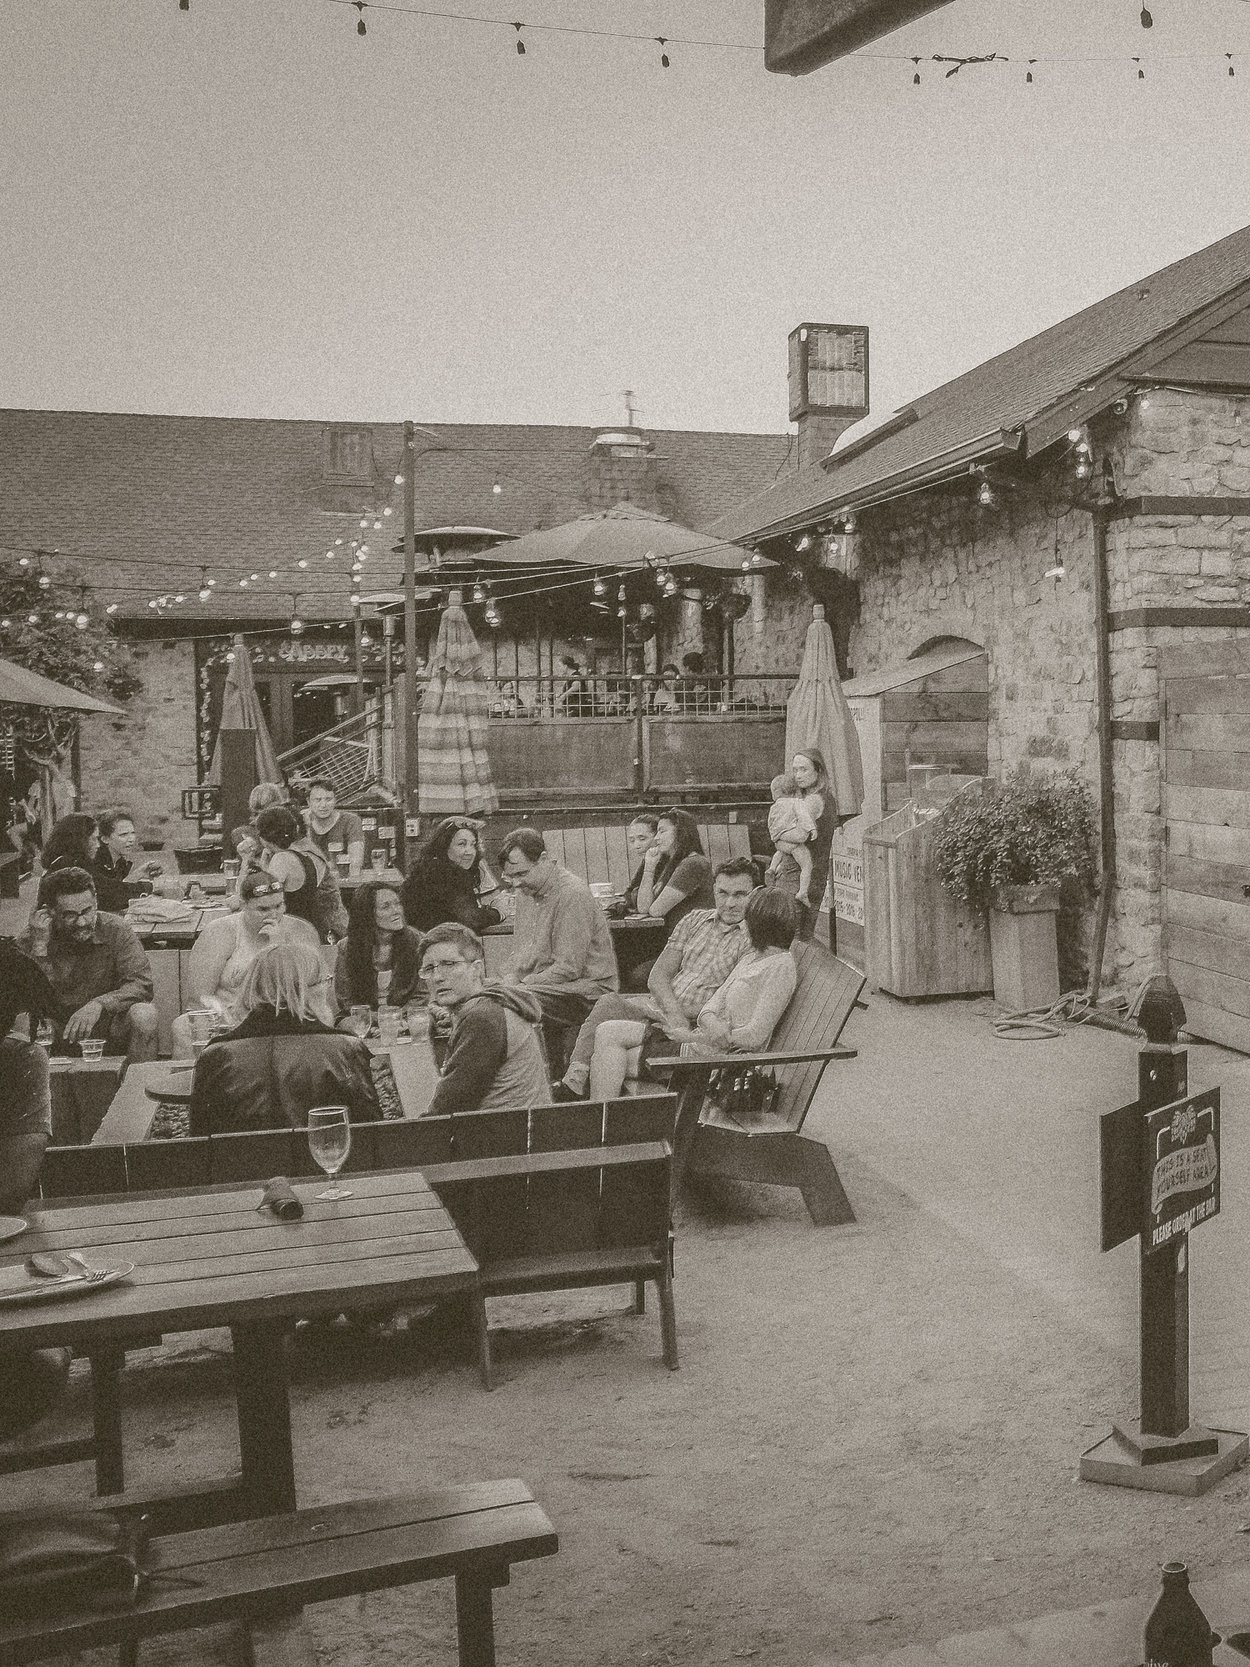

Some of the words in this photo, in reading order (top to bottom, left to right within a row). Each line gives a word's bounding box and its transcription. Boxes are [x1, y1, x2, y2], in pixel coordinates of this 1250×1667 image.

[1157, 1157, 1173, 1177] THIS
[1176, 1153, 1184, 1168] IS
[1157, 1168, 1190, 1195] YOURSELF
[1152, 1220, 1172, 1246] PLEASE
[1196, 1201, 1206, 1220] THE
